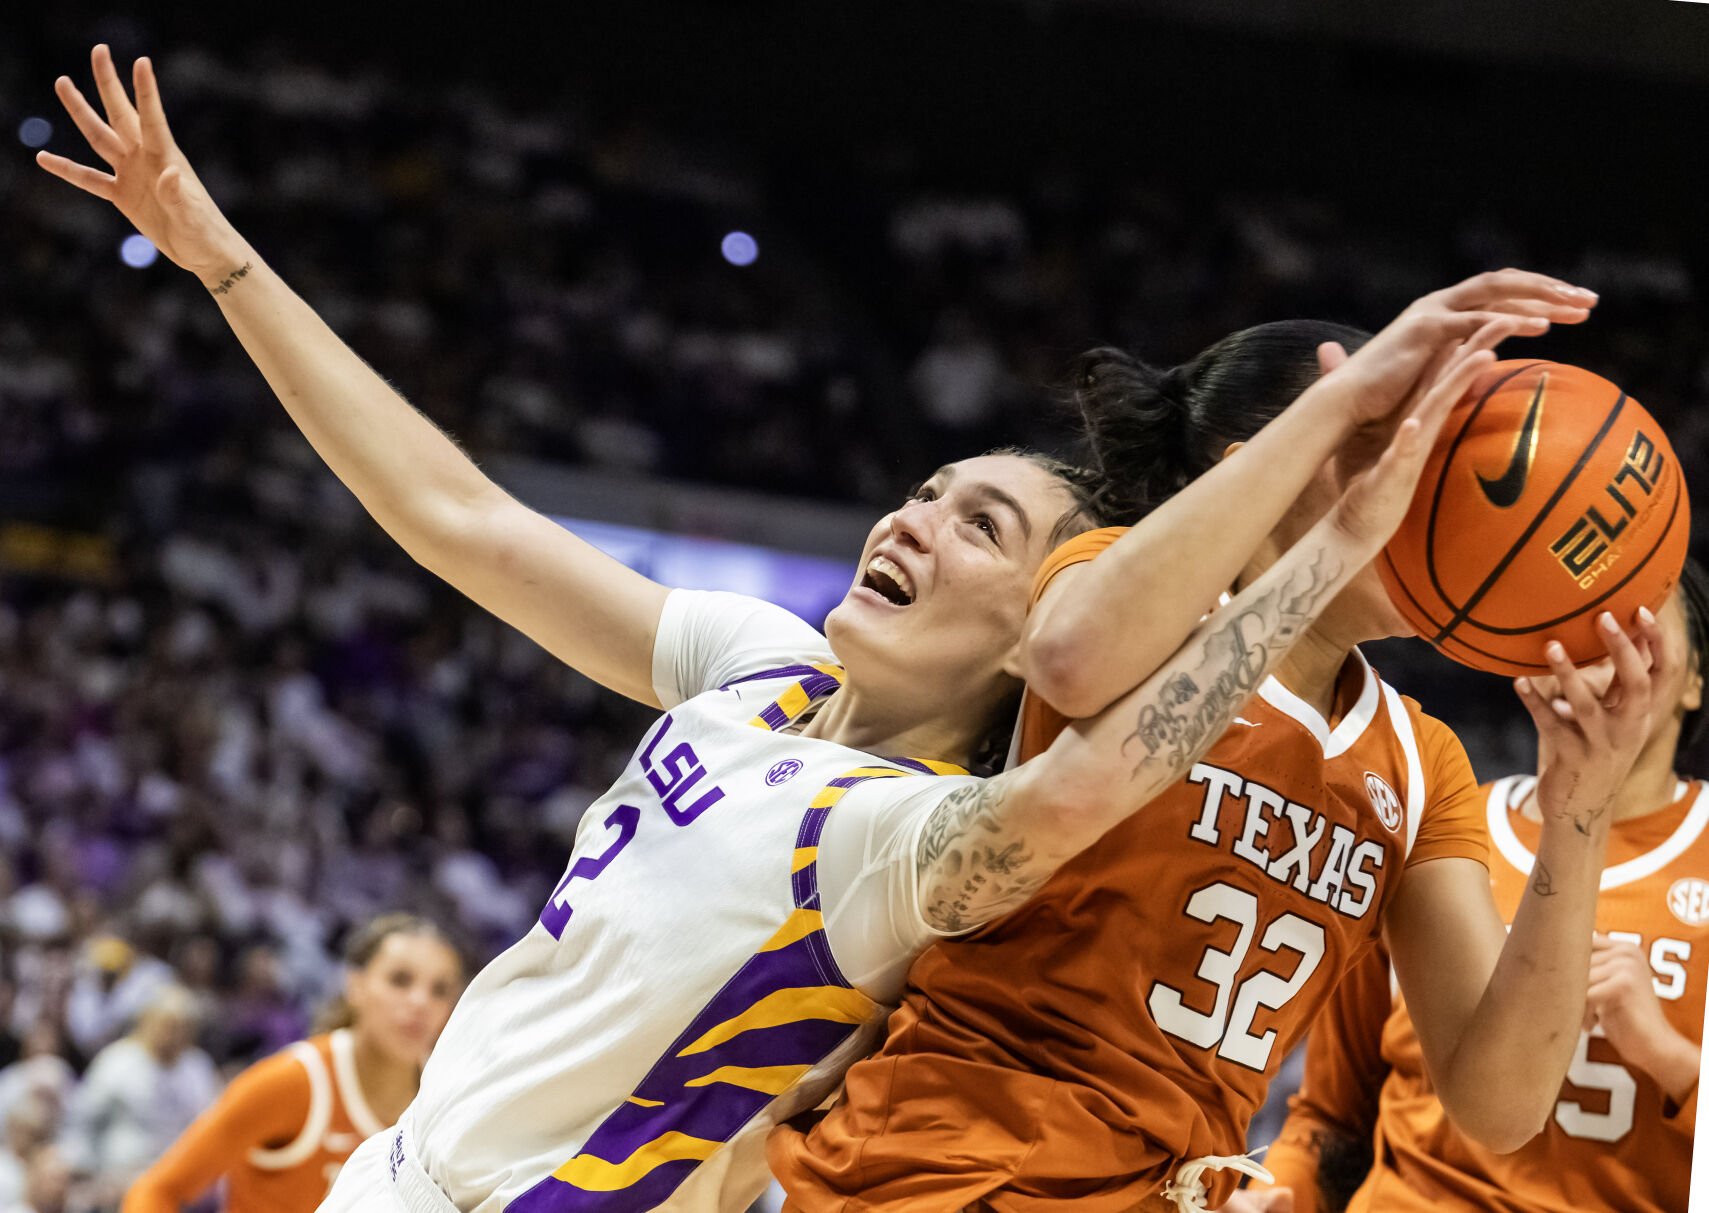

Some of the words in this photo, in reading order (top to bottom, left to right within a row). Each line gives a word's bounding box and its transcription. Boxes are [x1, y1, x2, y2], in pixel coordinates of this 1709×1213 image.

[1548, 429, 1665, 580] ELITE
[638, 713, 726, 827] LSU
[1186, 762, 1386, 920] TEXAS
[1365, 774, 1401, 830] SEC
[539, 804, 641, 942] 2
[1148, 882, 1326, 1074] 32
